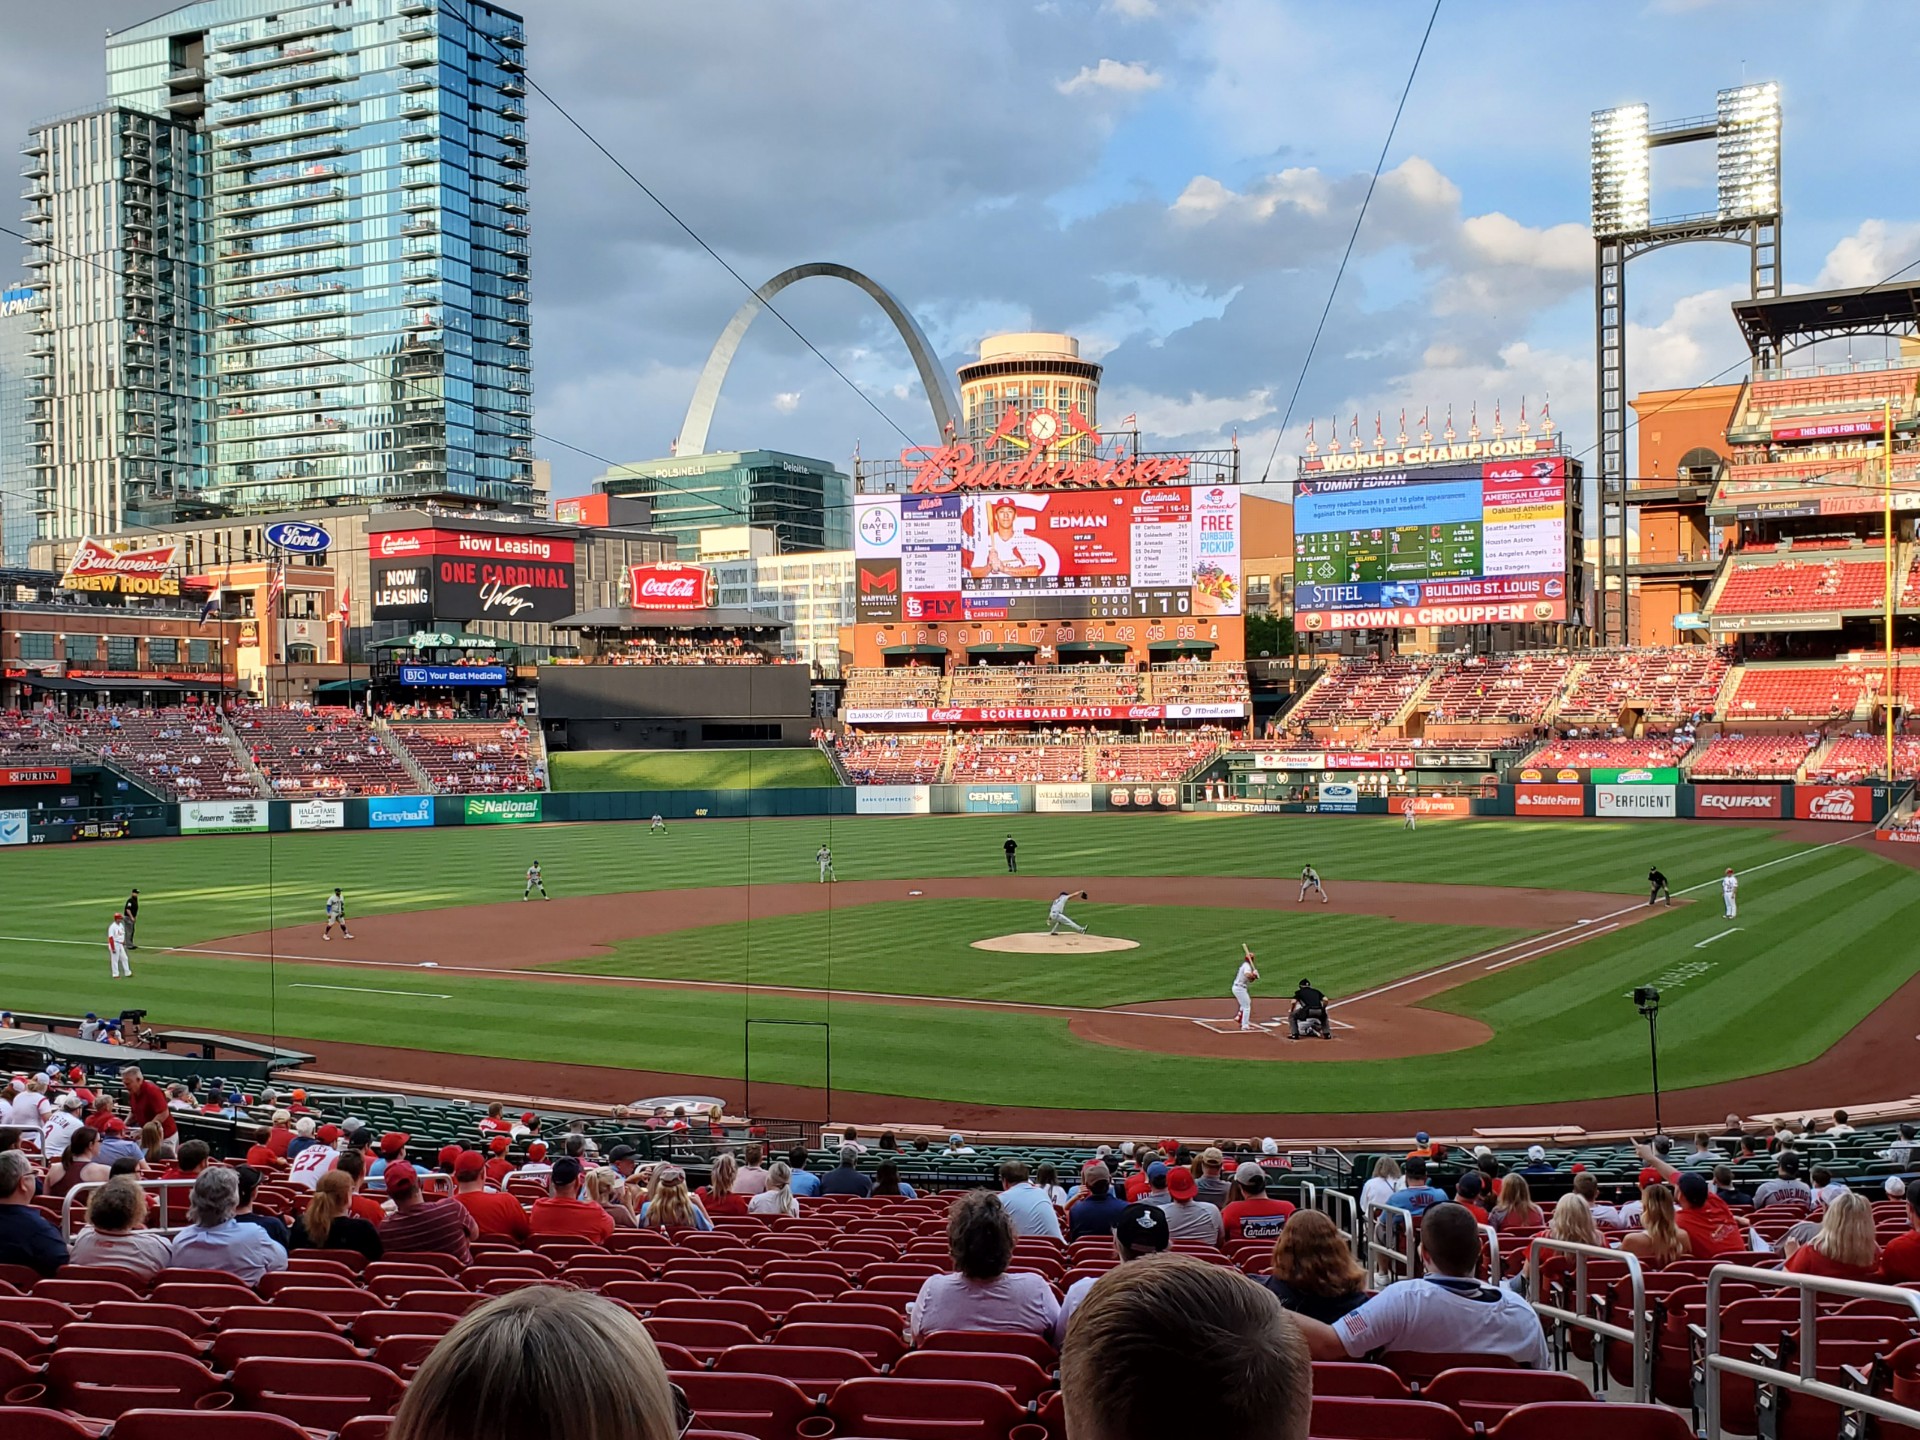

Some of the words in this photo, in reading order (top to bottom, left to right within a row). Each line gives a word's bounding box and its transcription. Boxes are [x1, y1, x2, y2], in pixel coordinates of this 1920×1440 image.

[1800, 427, 1817, 436] THIS
[1818, 426, 1839, 435] BUD'S
[1840, 425, 1854, 433] FOR
[1856, 424, 1872, 432] YOU.
[1321, 451, 1399, 472] WORLD
[1403, 438, 1537, 467] CHAMPIONS
[656, 465, 706, 479] POLSINELLI
[901, 444, 1191, 493] Budweiser
[1316, 479, 1361, 491] TOMMY
[1363, 474, 1407, 487] EDMAN
[1141, 490, 1181, 504] Cardinals
[1426, 493, 1465, 501] appearances
[1485, 492, 1528, 501] AMERICAN
[1529, 489, 1561, 498] LEAGUE
[1523, 504, 1554, 512] Athletics
[1824, 498, 1865, 513] THAT'S
[1871, 498, 1877, 509] A
[1050, 515, 1107, 528] EDMAN
[1201, 515, 1233, 531] FREE
[280, 525, 320, 547] Ford
[1200, 532, 1234, 540] CURBSIDE
[381, 535, 420, 554] Cardinals
[460, 535, 491, 551] Now
[496, 537, 550, 558] Leasing
[1200, 541, 1233, 553] PICKUP
[73, 549, 178, 572] Budweiser
[656, 561, 683, 571] Coca-Cola
[387, 569, 416, 586] NOW
[441, 562, 476, 584] ONE
[482, 565, 568, 589] CARDINAL
[64, 574, 117, 592] BREW
[120, 577, 180, 595] HOUSE
[641, 578, 697, 597] Coca-Cola
[1426, 584, 1481, 597] BUILDING
[1483, 583, 1501, 594] ST.
[1504, 581, 1540, 593] LOUIS
[375, 589, 428, 606] LEASING
[479, 576, 534, 616] Way
[1313, 586, 1362, 602] STIFEL
[924, 600, 956, 614] FLY
[1010, 598, 1015, 606] 0
[1138, 599, 1146, 613] 1
[1160, 599, 1167, 612] 1
[1178, 598, 1188, 612] 0
[1330, 610, 1399, 628] BROWN
[1403, 613, 1415, 624] &
[1418, 605, 1525, 623] CROUPPEN
[1720, 620, 1740, 630] Mercy
[917, 630, 927, 644] 2
[979, 629, 992, 643] 10
[1004, 628, 1018, 642] 14
[1030, 628, 1045, 642] 17
[1056, 628, 1074, 642] 20
[1086, 627, 1104, 642] 24
[1116, 626, 1135, 640] 42
[1146, 626, 1165, 640] 45
[1177, 626, 1196, 640] 85
[477, 639, 496, 647] Deck
[407, 671, 425, 680] BJC
[429, 672, 447, 680] Your
[449, 672, 466, 680] Best
[468, 672, 502, 680] Medicine
[850, 711, 883, 720] CLARKSON
[895, 711, 924, 719] JEWELERS
[932, 709, 963, 720] Coca-Cola
[981, 706, 1067, 718] SCOREBOARD
[1073, 707, 1112, 718] PATIO
[1128, 706, 1161, 717] Coca-Cola
[1422, 758, 1441, 766] Mercy
[20, 772, 56, 780] PURINA
[969, 792, 1013, 800] CENTENE
[1329, 787, 1348, 795] Ford
[1217, 803, 1243, 812] BUSCH
[1244, 803, 1280, 812] STADIUM
[1599, 793, 1671, 808] PERFICIENT
[1701, 795, 1772, 810] EQUIFAX
[1810, 797, 1854, 814] Club
[198, 814, 224, 822] Ameren
[293, 1154, 326, 1172] 27
[1411, 1196, 1436, 1207] SMITH
[1243, 1225, 1284, 1239] Cardinals
